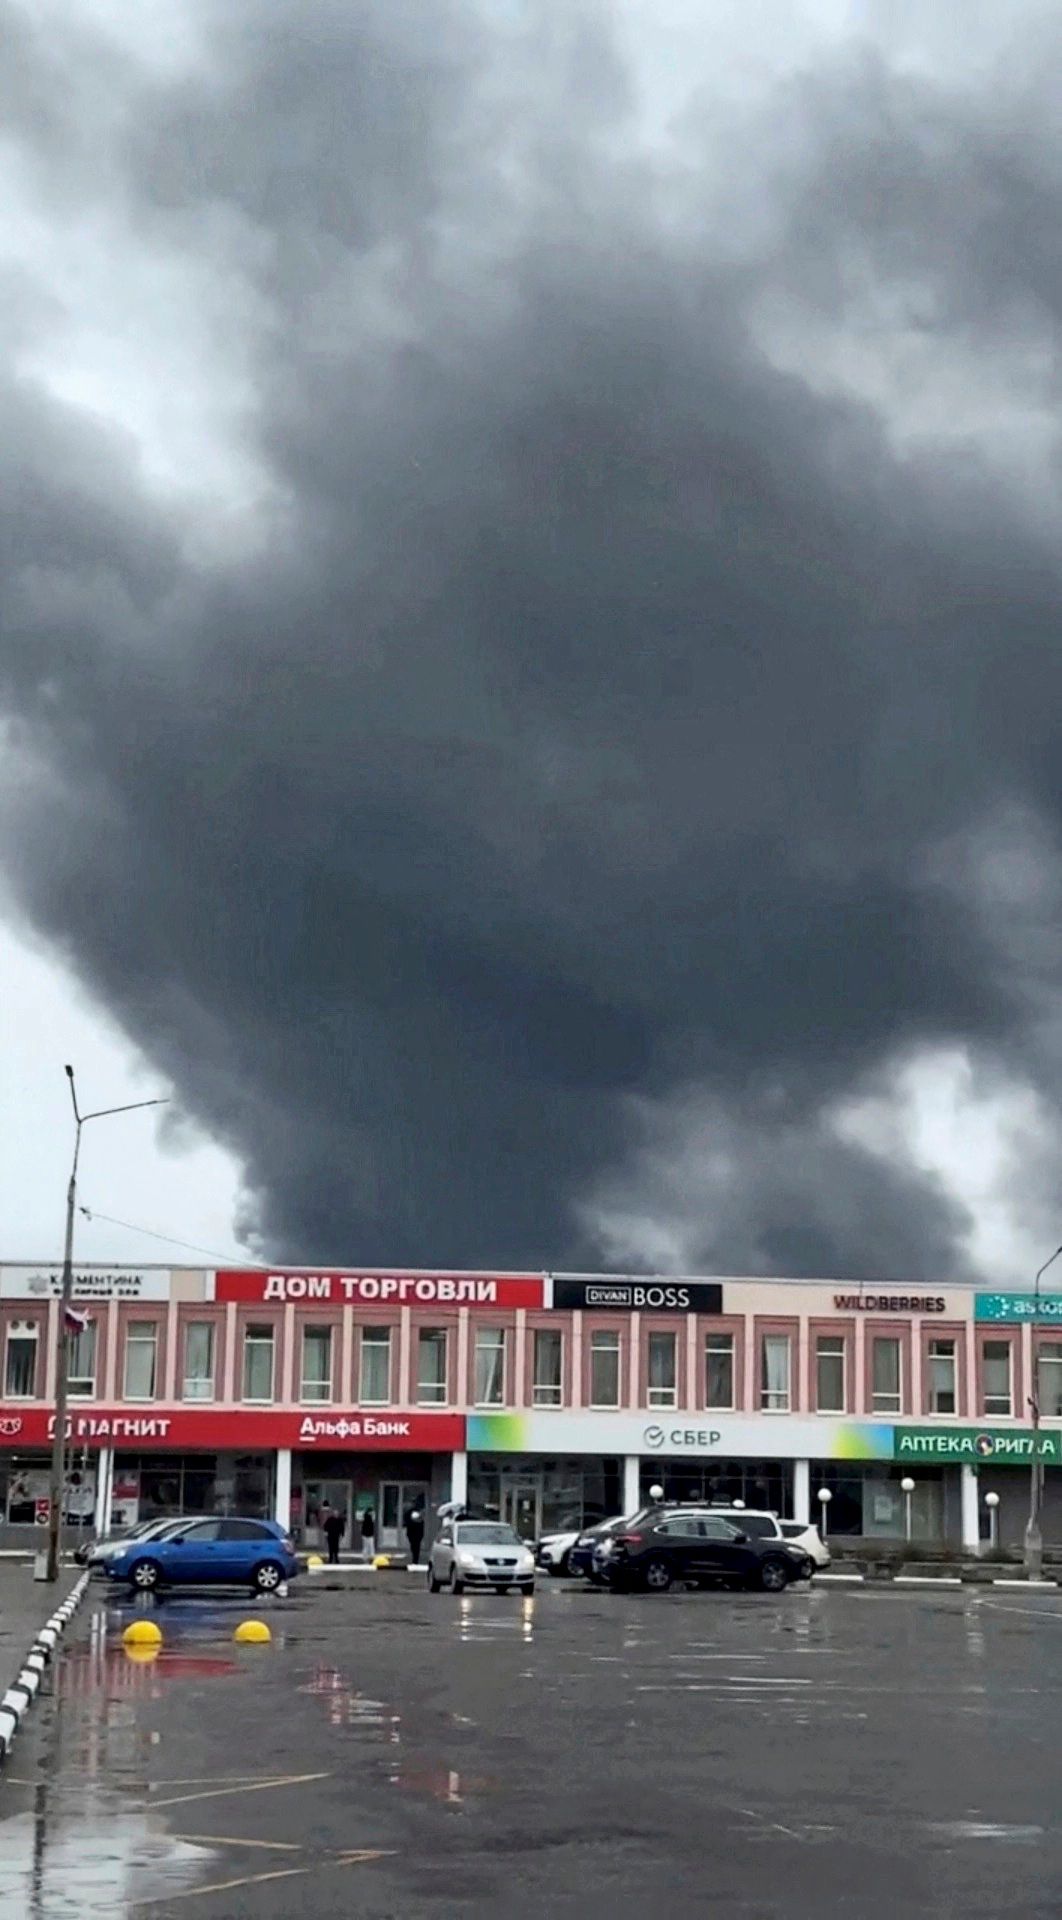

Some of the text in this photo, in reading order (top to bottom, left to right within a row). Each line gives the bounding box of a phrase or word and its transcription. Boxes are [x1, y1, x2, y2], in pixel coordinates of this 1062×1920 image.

[50, 1275, 141, 1285] КМЕНТИНА
[263, 1276, 497, 1301] ДОМ ТОРГОВЛИ
[590, 1288, 689, 1307] DIVAN BOSS
[833, 1295, 946, 1312] WILDBERRIES
[77, 1418, 171, 1436] МАГНИТ
[299, 1417, 410, 1440] Альфа Банк
[670, 1430, 721, 1446] СБЕР
[900, 1435, 974, 1452] АПТЕКА
